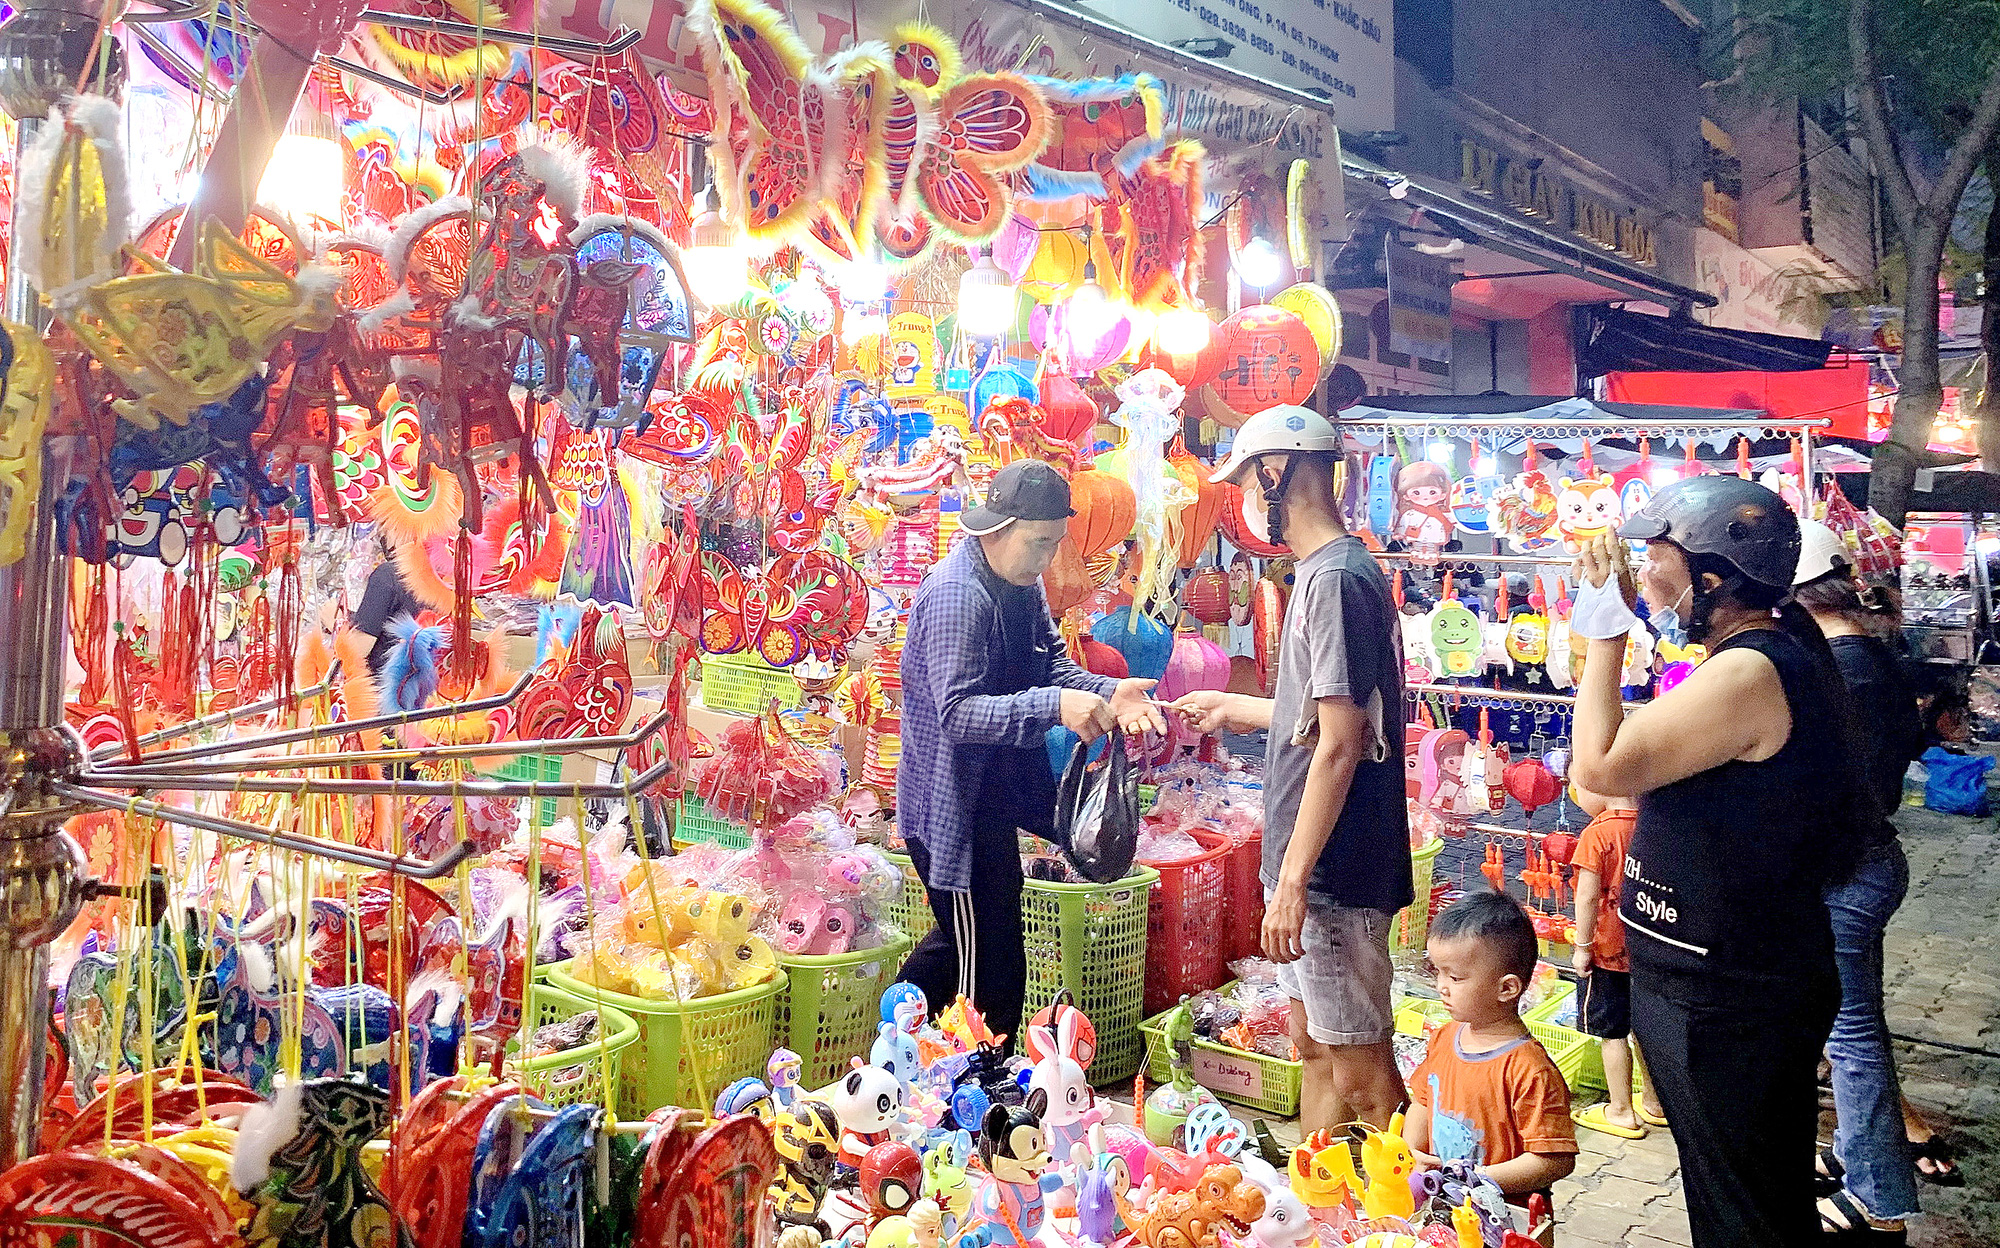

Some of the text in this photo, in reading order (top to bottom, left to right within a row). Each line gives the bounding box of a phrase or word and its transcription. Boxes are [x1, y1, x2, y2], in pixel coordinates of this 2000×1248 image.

[1215, 101, 1243, 141] CAO
[897, 321, 927, 334] Trung
[940, 404, 967, 419] Trung
[1635, 891, 1678, 923] Style
